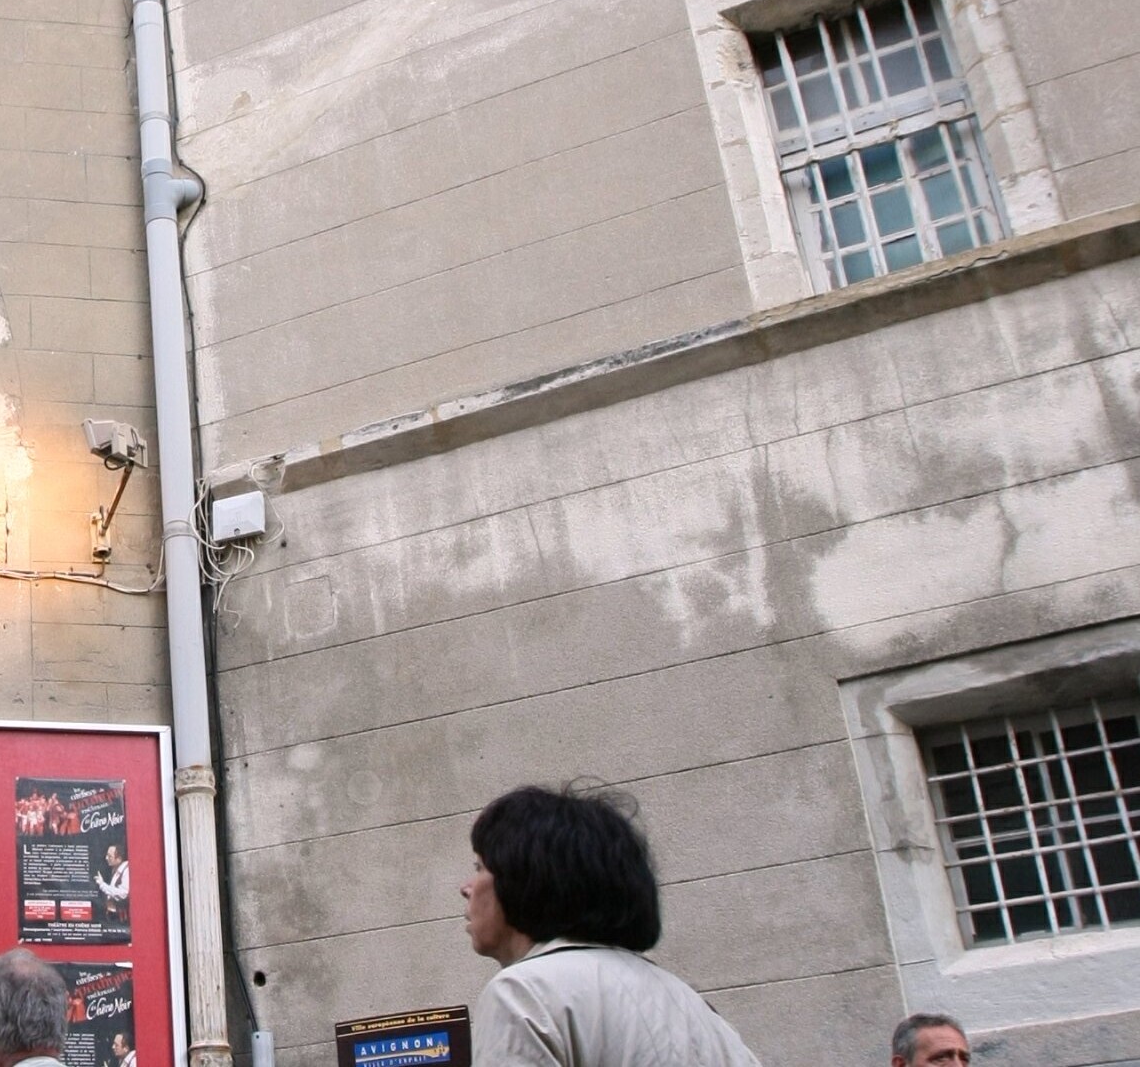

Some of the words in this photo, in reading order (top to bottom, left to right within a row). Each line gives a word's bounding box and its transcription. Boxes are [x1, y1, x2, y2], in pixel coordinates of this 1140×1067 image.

[407, 1016, 416, 1024] de
[426, 1013, 450, 1021] culture
[361, 1037, 434, 1056] AVIGNON
